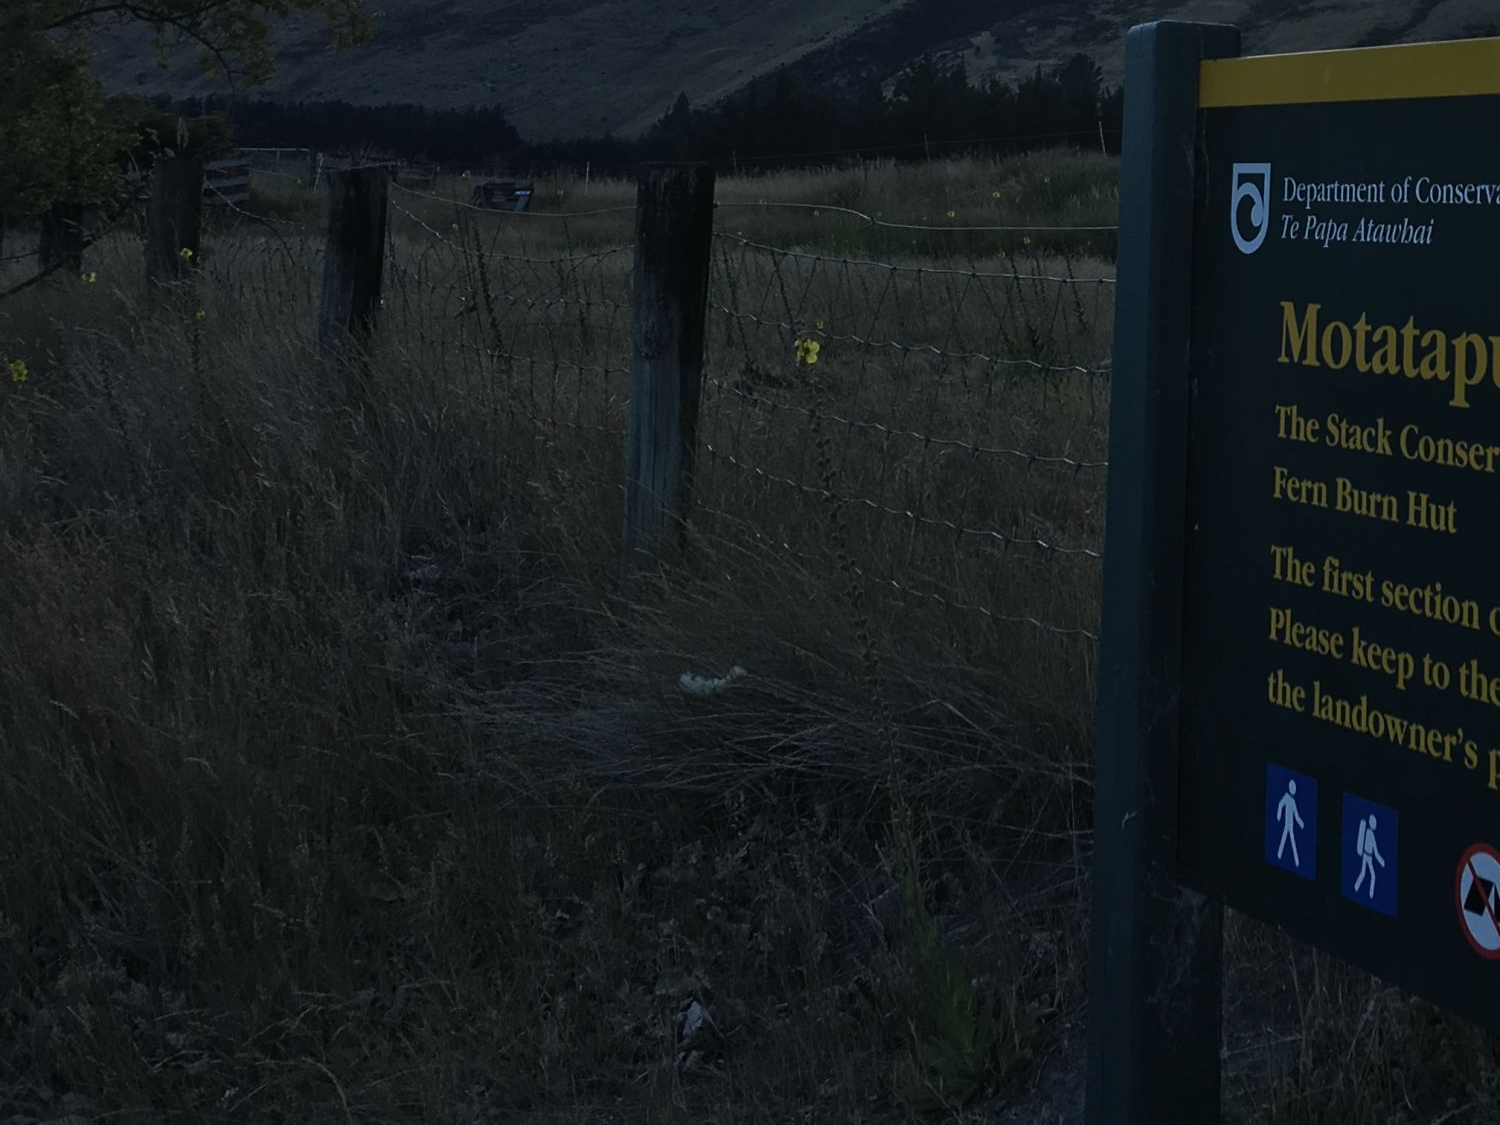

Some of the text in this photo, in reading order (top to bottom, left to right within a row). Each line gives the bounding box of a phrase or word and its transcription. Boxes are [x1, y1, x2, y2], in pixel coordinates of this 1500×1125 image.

[1283, 177, 1386, 209] Department
[1391, 177, 1411, 202] of
[1281, 215, 1433, 247] Te Papa Atawhai
[1275, 406, 1318, 443] The
[1327, 414, 1392, 455] Stack
[1274, 466, 1327, 507] Fern
[1337, 478, 1397, 521] Burn
[1408, 492, 1456, 533] Hut
[1271, 545, 1315, 587] The
[1323, 557, 1373, 602] first
[1381, 580, 1481, 629] section
[1269, 607, 1344, 658] Please
[1351, 627, 1415, 689] keep
[1423, 653, 1450, 688] to
[1268, 670, 1305, 710] the
[1312, 681, 1477, 768] landowner's
